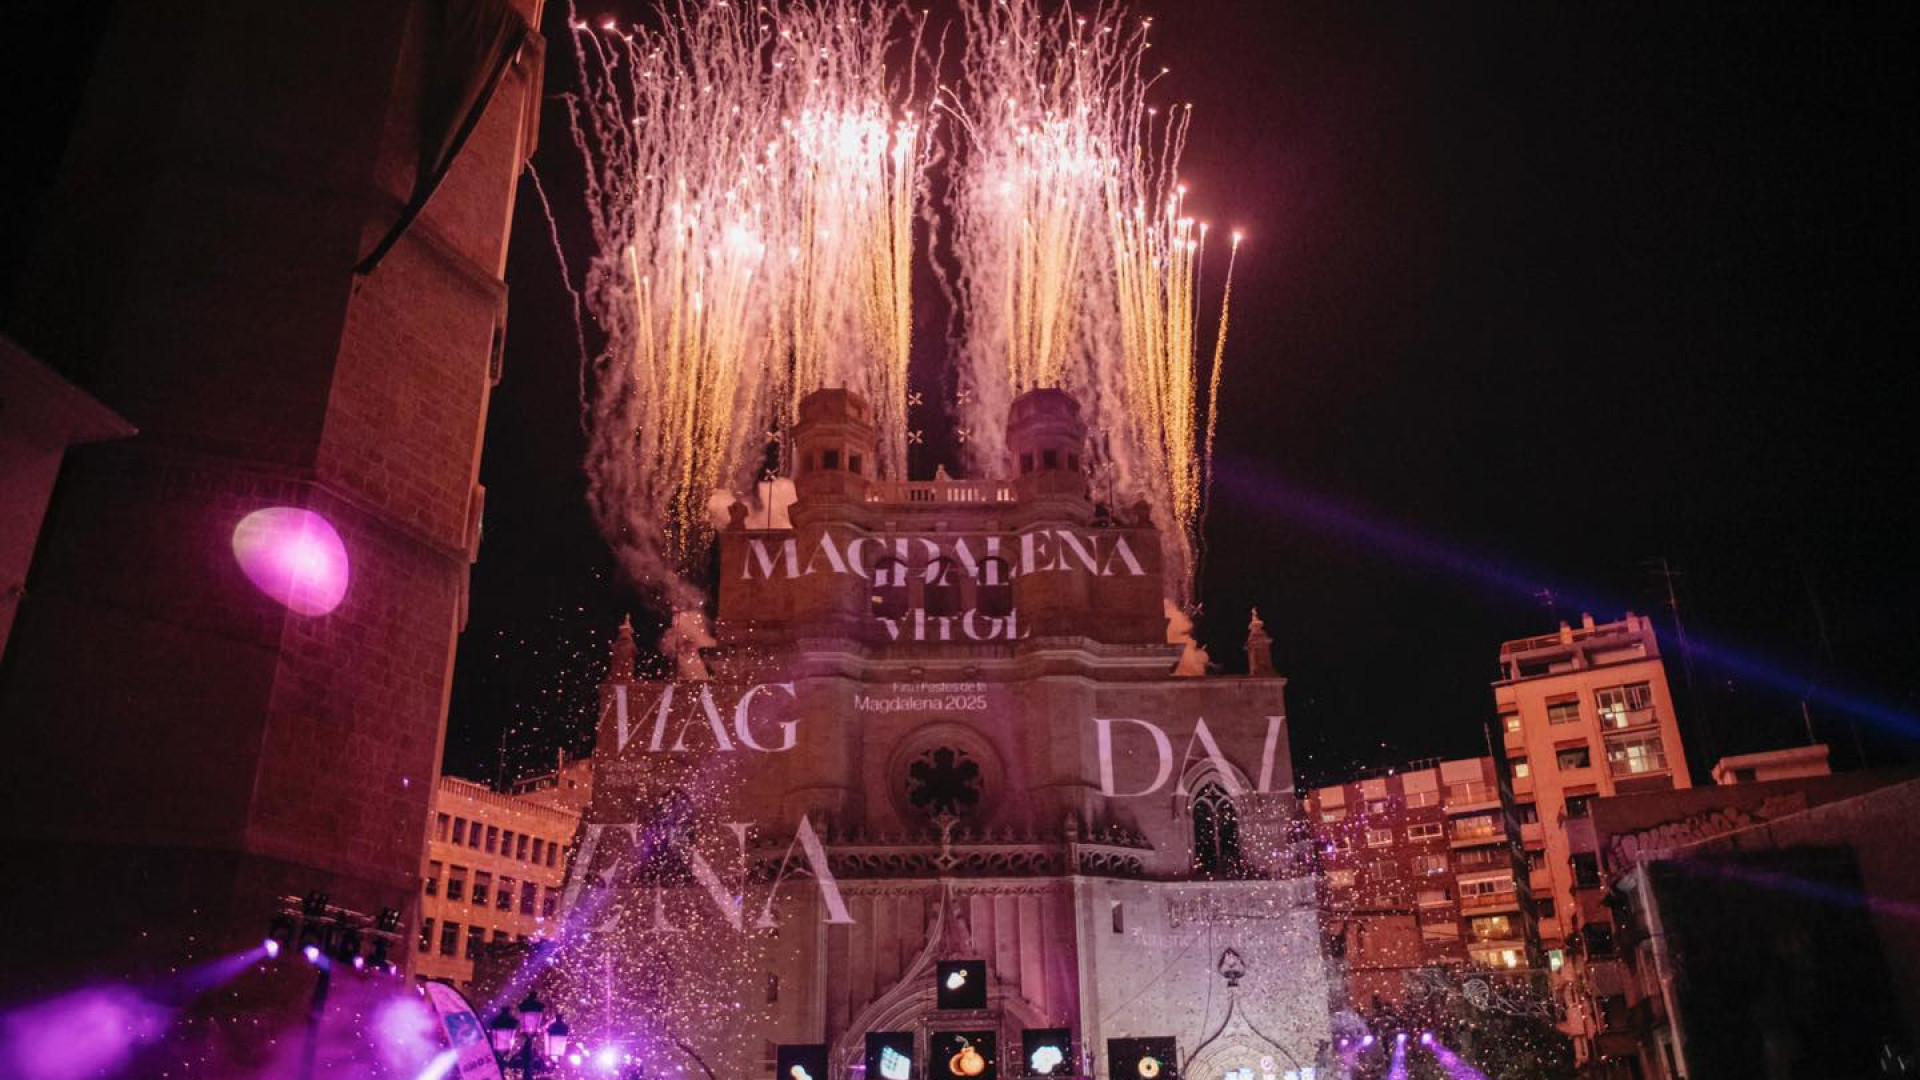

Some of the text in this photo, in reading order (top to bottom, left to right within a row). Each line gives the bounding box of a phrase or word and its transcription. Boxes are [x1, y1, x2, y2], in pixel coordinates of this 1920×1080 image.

[742, 530, 1146, 587] MAGDALENA
[598, 682, 801, 752] MAG
[853, 694, 988, 713] Magdalena 2025
[561, 814, 856, 933] ENA
